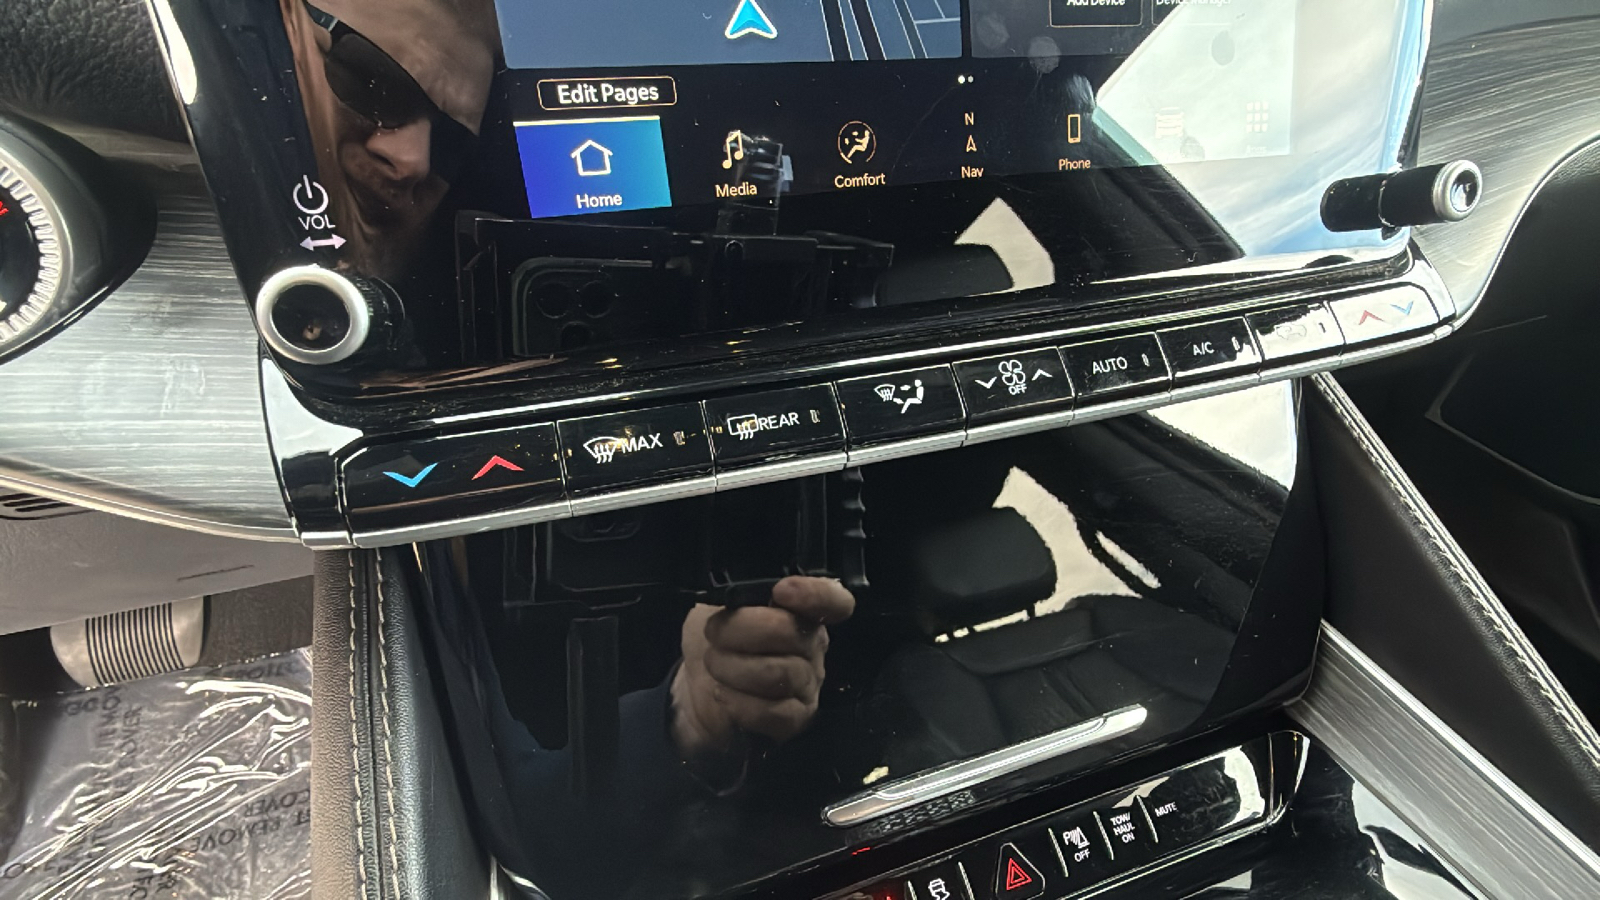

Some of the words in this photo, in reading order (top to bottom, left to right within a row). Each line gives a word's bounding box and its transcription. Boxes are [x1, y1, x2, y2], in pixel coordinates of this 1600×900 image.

[557, 83, 598, 106] Edit
[601, 82, 659, 107] Pages
[964, 112, 975, 125] N
[961, 165, 985, 179] Nav
[1058, 157, 1092, 172] Phone
[833, 172, 887, 190] Comfort
[714, 181, 759, 199] Media
[575, 191, 623, 210] Home
[297, 214, 335, 231] VOL
[1193, 342, 1214, 356] A/C
[1092, 357, 1128, 374] AUTO
[1008, 384, 1027, 396] OFF
[757, 411, 800, 431] REAR
[622, 433, 663, 453] MAX
[1154, 802, 1178, 817] MUTE
[1110, 812, 1132, 826] TOW/
[1113, 822, 1135, 838] HAUL
[1121, 832, 1135, 843] ON
[1074, 849, 1090, 862] OFF
